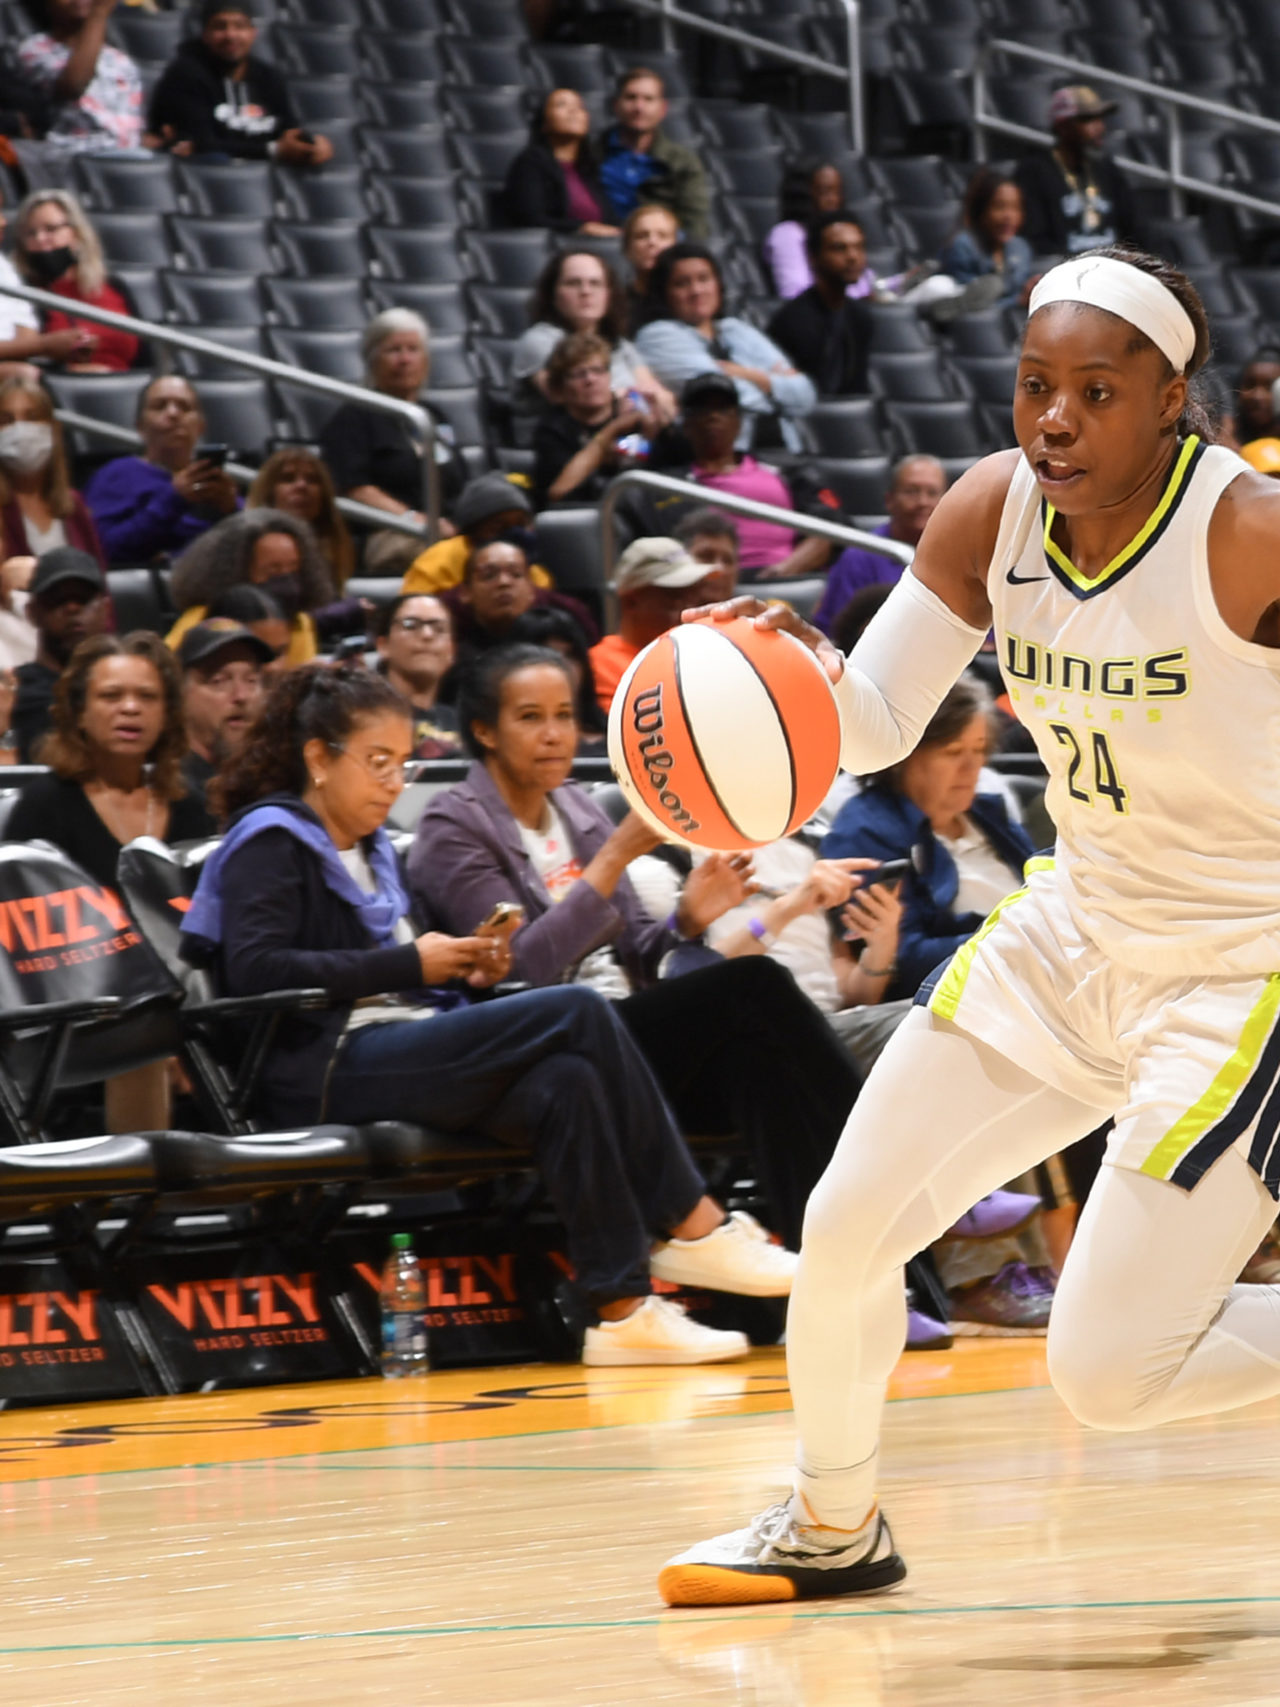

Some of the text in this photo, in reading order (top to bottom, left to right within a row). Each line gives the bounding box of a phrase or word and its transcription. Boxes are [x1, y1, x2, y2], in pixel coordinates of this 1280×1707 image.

[1005, 631, 1192, 702] WINGS
[1011, 687, 1163, 724] DALLAS
[633, 682, 702, 833] Wilson
[1046, 720, 1131, 816] 24
[0, 1289, 100, 1347] ZZY
[147, 1272, 321, 1331] VIZZY
[23, 1346, 107, 1366] SELTZER
[194, 1327, 328, 1352] HARD SELTZER
